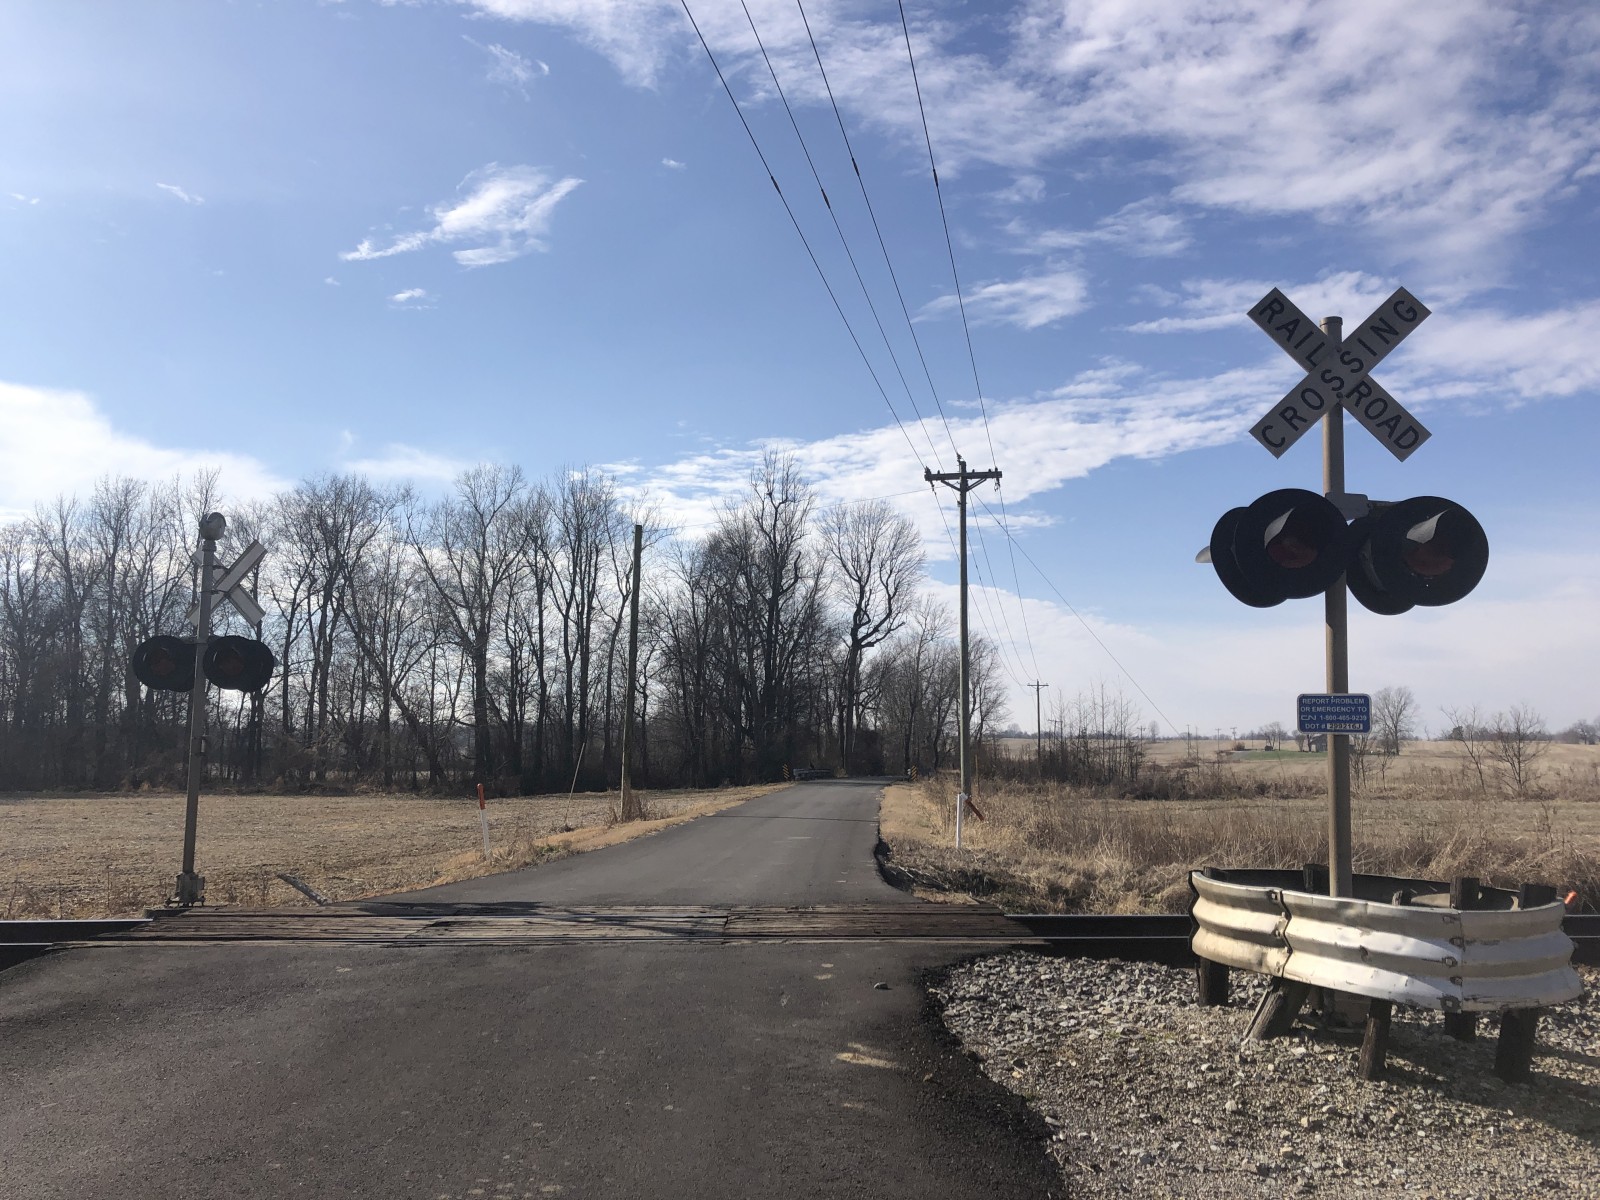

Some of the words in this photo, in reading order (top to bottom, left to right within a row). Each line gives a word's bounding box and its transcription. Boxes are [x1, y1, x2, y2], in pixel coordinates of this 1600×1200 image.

[1258, 297, 1326, 368] RAIL
[1345, 380, 1420, 450] ROAD
[1260, 300, 1418, 449] CROSSING
